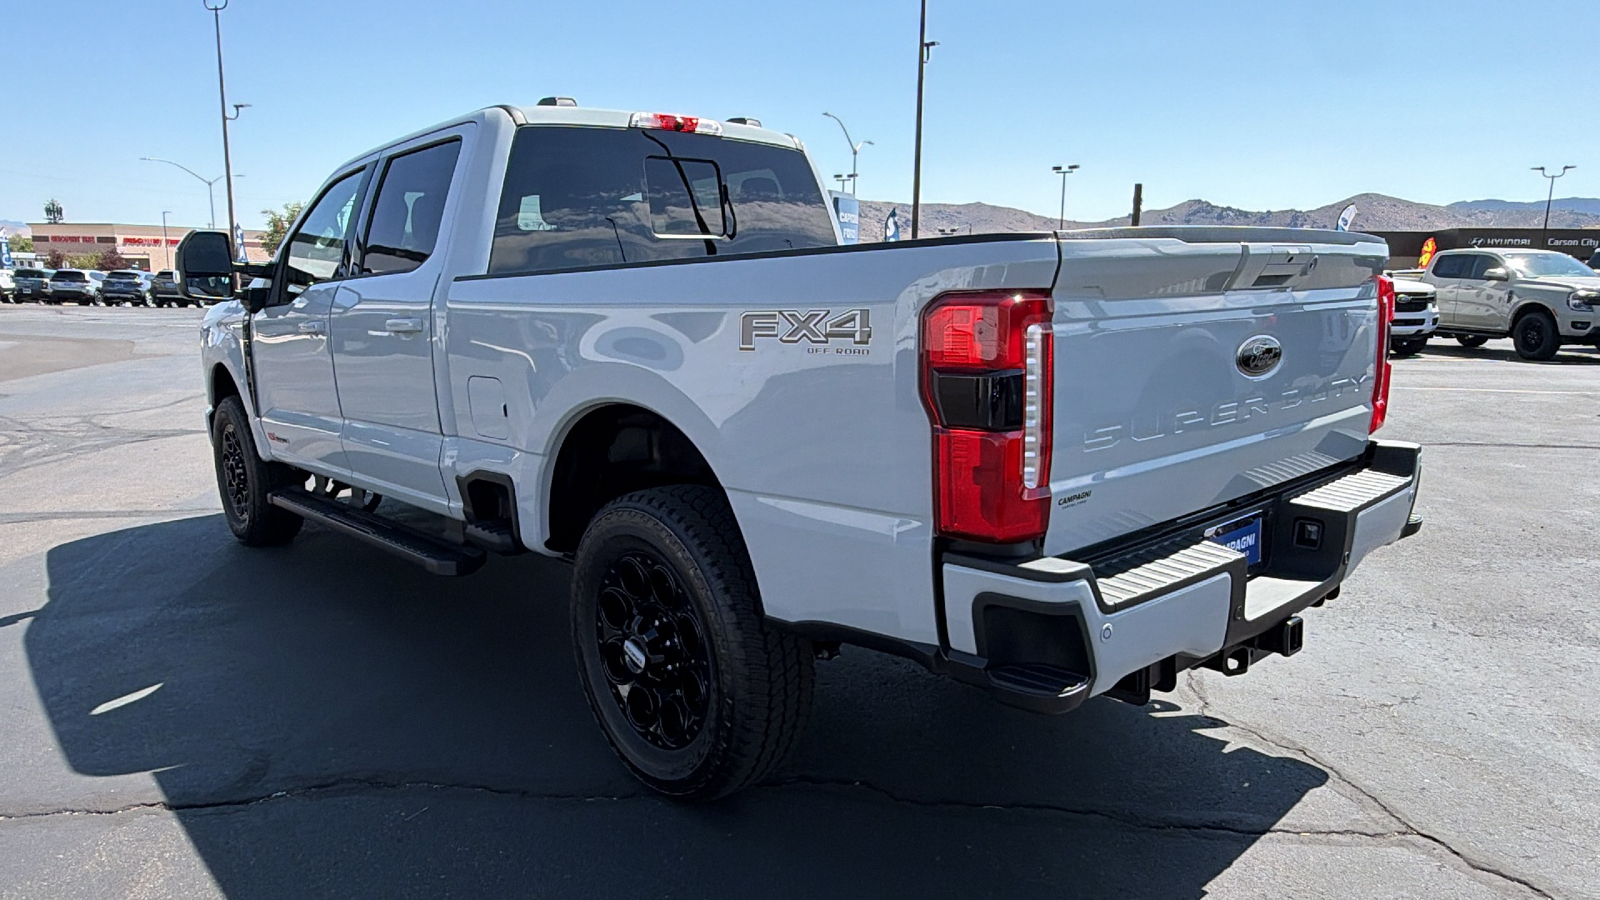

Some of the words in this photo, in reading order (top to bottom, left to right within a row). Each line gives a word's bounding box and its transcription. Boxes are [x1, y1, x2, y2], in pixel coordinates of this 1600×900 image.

[1487, 238, 1531, 246] HYUNDAI
[1547, 237, 1579, 246] Carson
[1580, 237, 1600, 248] City
[739, 308, 872, 351] FX4
[806, 347, 832, 355] OFF
[835, 347, 871, 356] ROAD
[1082, 392, 1269, 453] SUPER
[1057, 489, 1092, 506] CAMPAGNI
